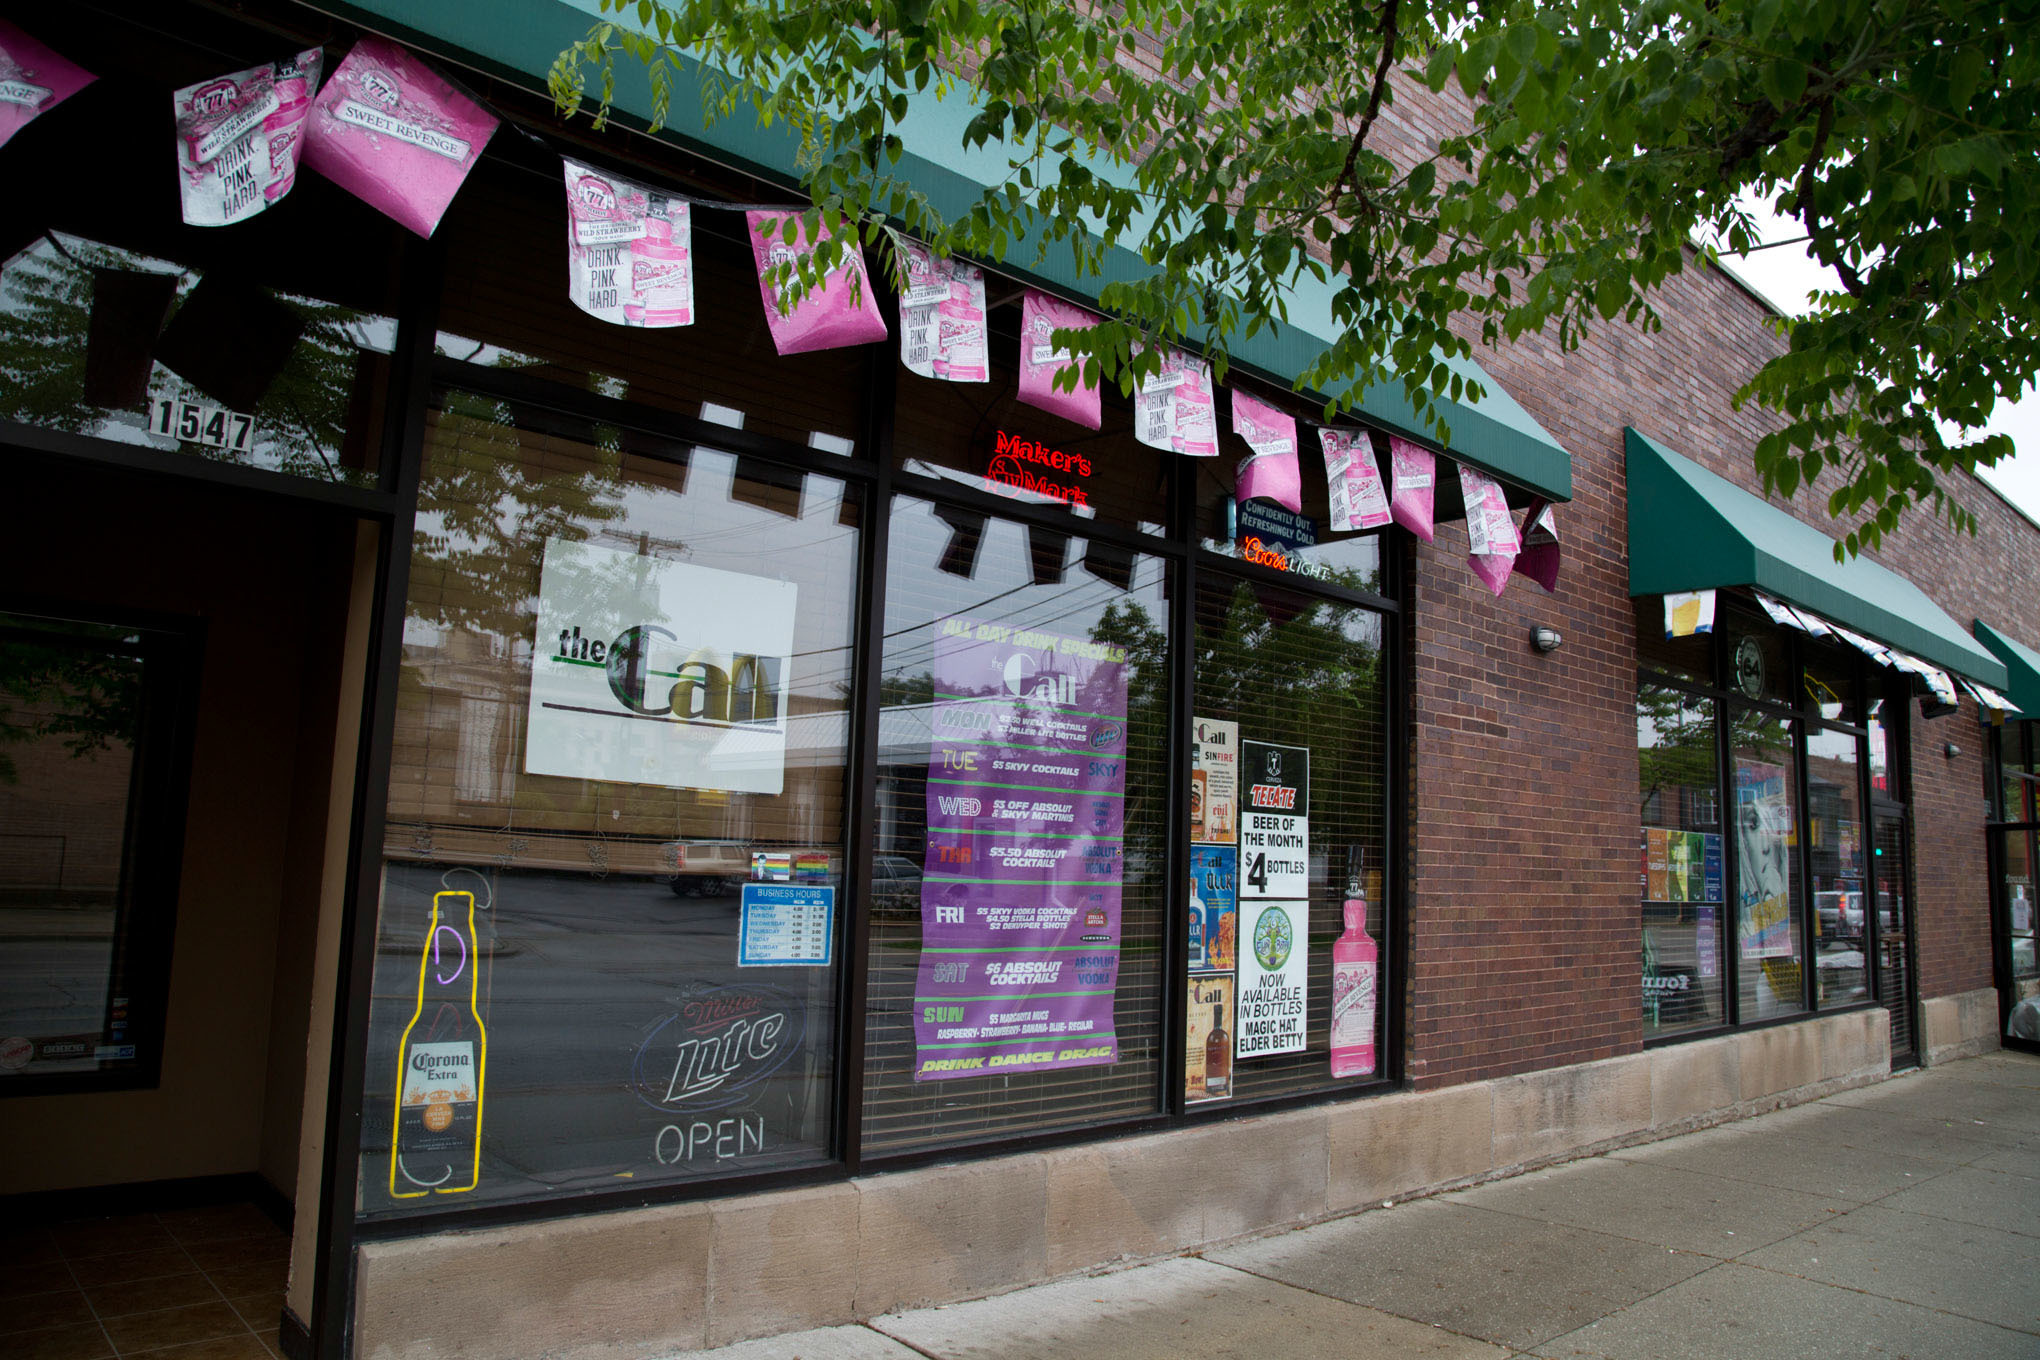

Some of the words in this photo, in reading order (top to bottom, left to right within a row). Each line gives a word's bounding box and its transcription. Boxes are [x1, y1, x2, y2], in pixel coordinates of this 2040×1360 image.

[369, 77, 388, 97] 77
[203, 92, 224, 110] 77
[345, 106, 393, 129] SWEET
[395, 124, 458, 153] REVENGE
[587, 191, 604, 206] 77
[578, 229, 595, 237] WILD
[596, 225, 641, 236] STRAWBERRY
[587, 247, 624, 268] DRINK.
[591, 268, 618, 288] PINK.
[588, 289, 620, 310] HARD.
[157, 400, 250, 449] 1547
[994, 430, 1091, 477] Maker's
[1245, 536, 1289, 571] Coors
[1289, 557, 1330, 580] LIGHT
[942, 618, 973, 639] ALL
[976, 624, 1012, 645] DAY
[1013, 629, 1059, 652] DRINK
[1060, 638, 1126, 664] SPECIALS
[559, 626, 607, 663] the
[605, 624, 783, 727] Call
[1003, 653, 1078, 706] Call
[941, 709, 992, 731] MON
[1022, 717, 1044, 728] WELL
[1046, 719, 1087, 733] COCKTAILS
[1009, 726, 1037, 736] MILLER
[1055, 730, 1087, 742] BOTTLES
[1198, 723, 1226, 745] Call
[942, 748, 978, 771] TUE
[1205, 751, 1233, 762] SINFIRE
[1031, 763, 1080, 776] COCKTAILS
[1087, 761, 1119, 777] SKYY
[938, 796, 982, 816] WED
[1250, 784, 1297, 810] TECATE
[1007, 800, 1030, 810] OFF
[1031, 801, 1073, 813] ABSOLUT
[1031, 810, 1074, 822] MARTINIS
[1253, 816, 1280, 830] BEER
[1282, 818, 1296, 831] OF
[1244, 832, 1265, 846] THE
[1267, 834, 1303, 848] MONTH
[1002, 857, 1056, 868] COCKTAILS
[1024, 848, 1068, 859] ABSOLUT
[1267, 860, 1305, 874] BOTTLES
[757, 888, 794, 898] BUSINESS
[795, 890, 821, 899] HOURS
[936, 906, 965, 924] FRI
[1010, 915, 1036, 923] STELLA
[1013, 908, 1036, 916] VODKA
[1037, 908, 1078, 916] COCKTAILS
[1042, 922, 1068, 930] SHOTS
[984, 962, 1001, 975] $6
[1003, 961, 1063, 974] ABSOLUT
[1074, 955, 1115, 969] ABSOLUT
[932, 962, 970, 983] SAT
[990, 972, 1060, 986] COCKTAILS
[1078, 972, 1110, 986] VODKA
[1259, 973, 1286, 987] NOW
[1194, 983, 1222, 1005] Call
[1241, 986, 1301, 1004] AVAILABLE
[684, 996, 763, 1024] Miller
[923, 1006, 965, 1024] SUN
[999, 1011, 1031, 1024] MARGARITA
[1239, 1004, 1251, 1019] IN
[1253, 1001, 1303, 1019] BOTTLES
[1068, 1020, 1094, 1031] REGULAR
[1245, 1019, 1276, 1036] MAGIC
[1279, 1018, 1298, 1033] HAT
[1240, 1035, 1270, 1053] ELDER
[1272, 1032, 1304, 1049] BETTY
[412, 1052, 470, 1072] Corona
[662, 1012, 785, 1103] Lite
[921, 1057, 986, 1072] DRINK
[988, 1051, 1056, 1067] DANCE
[1058, 1046, 1113, 1061] DRAG
[427, 1069, 458, 1081] Extra
[656, 1116, 764, 1165] OPEN
